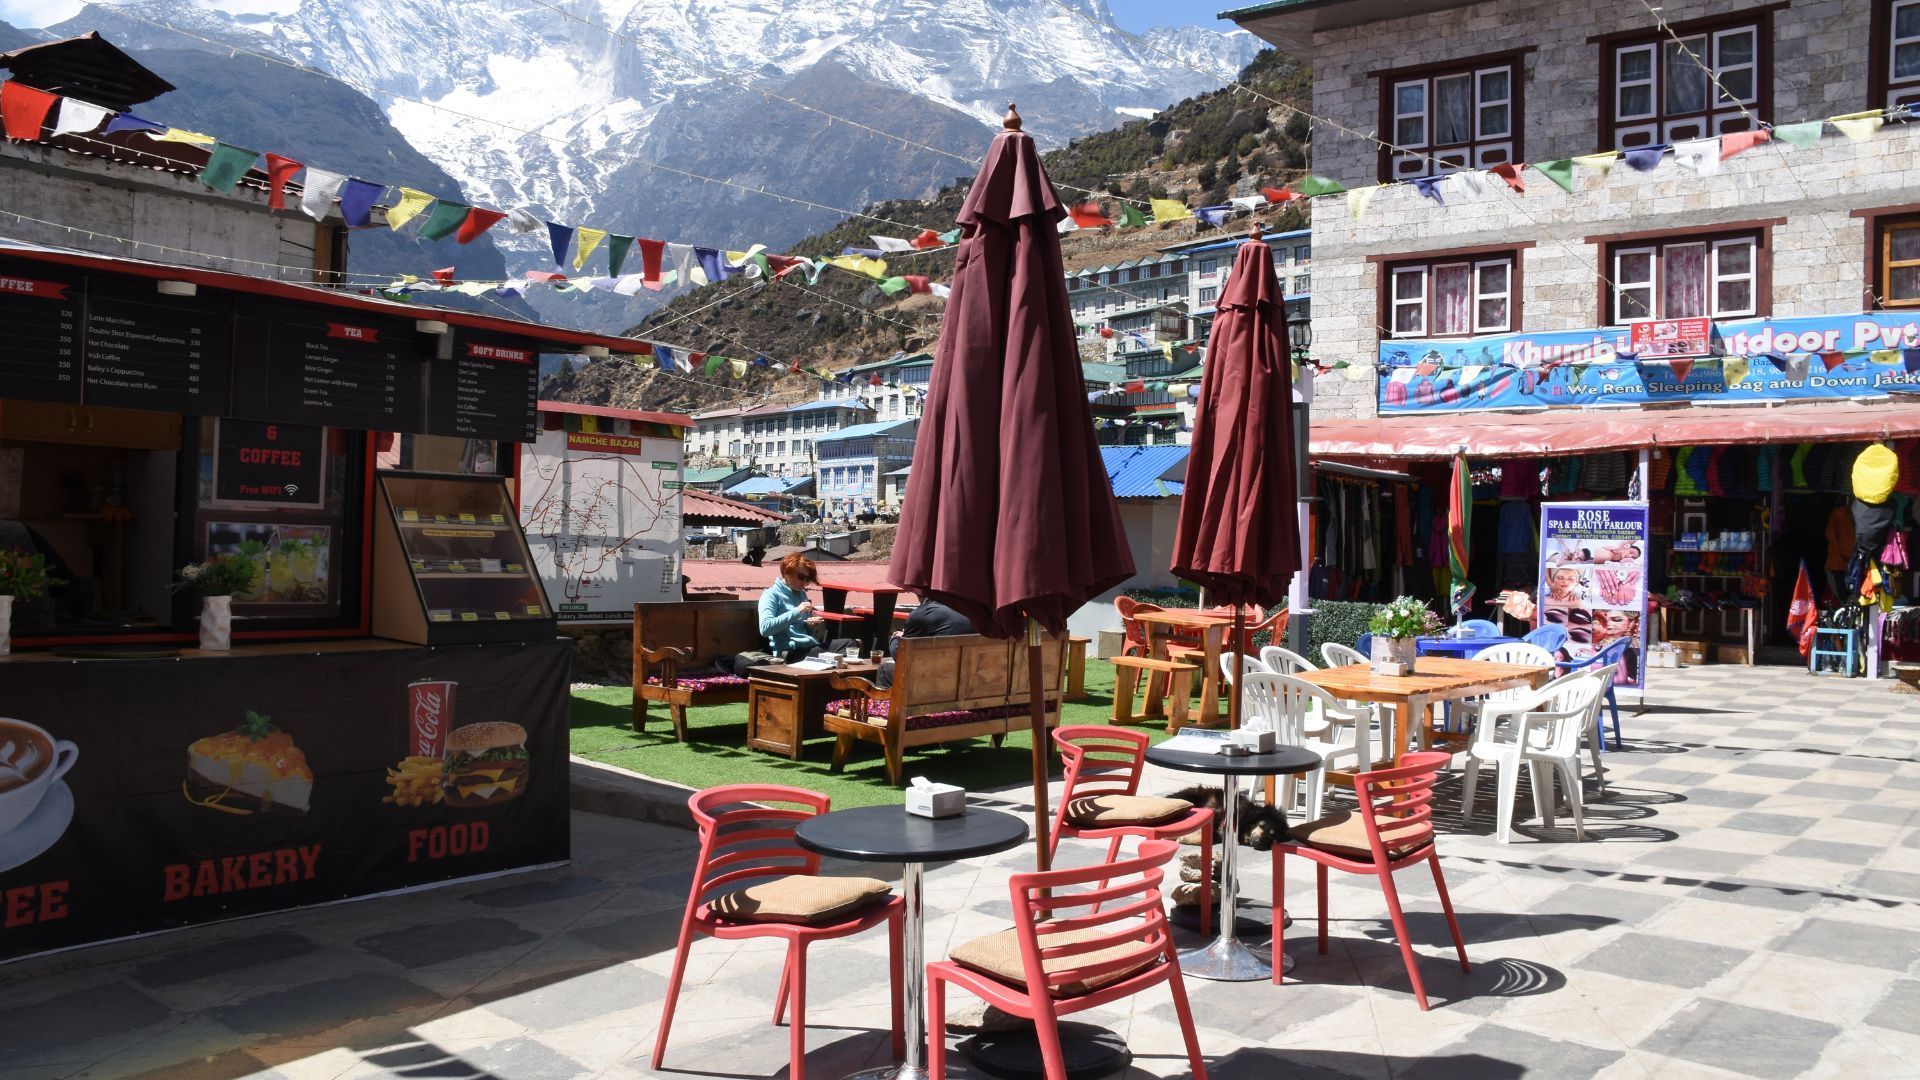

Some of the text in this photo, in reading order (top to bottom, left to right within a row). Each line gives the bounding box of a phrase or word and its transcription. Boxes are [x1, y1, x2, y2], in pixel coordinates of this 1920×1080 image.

[106, 316, 136, 326] Macchiato
[89, 327, 110, 335] Double
[344, 328, 362, 337] TEA
[101, 341, 130, 350] Chocolate
[1724, 327, 1840, 354] tdoor
[474, 346, 524, 360] SOFT DRINKS
[100, 379, 129, 387] Chocolate
[1567, 384, 1598, 395] We
[1603, 383, 1643, 394] Rent
[1648, 382, 1723, 394] Sleeping
[1810, 375, 1867, 388] Down
[569, 435, 640, 448] NAMCHE BAZAR
[240, 448, 302, 466] COFFEE
[240, 485, 258, 494] Free
[1578, 510, 1610, 521] ROSE
[1549, 520, 1563, 528] SPA
[1572, 521, 1603, 529] BEAUTY
[1605, 521, 1642, 530] PARLOUR
[408, 820, 489, 863] FOOD
[164, 844, 322, 902] BAKERY
[0, 880, 69, 928] EE
